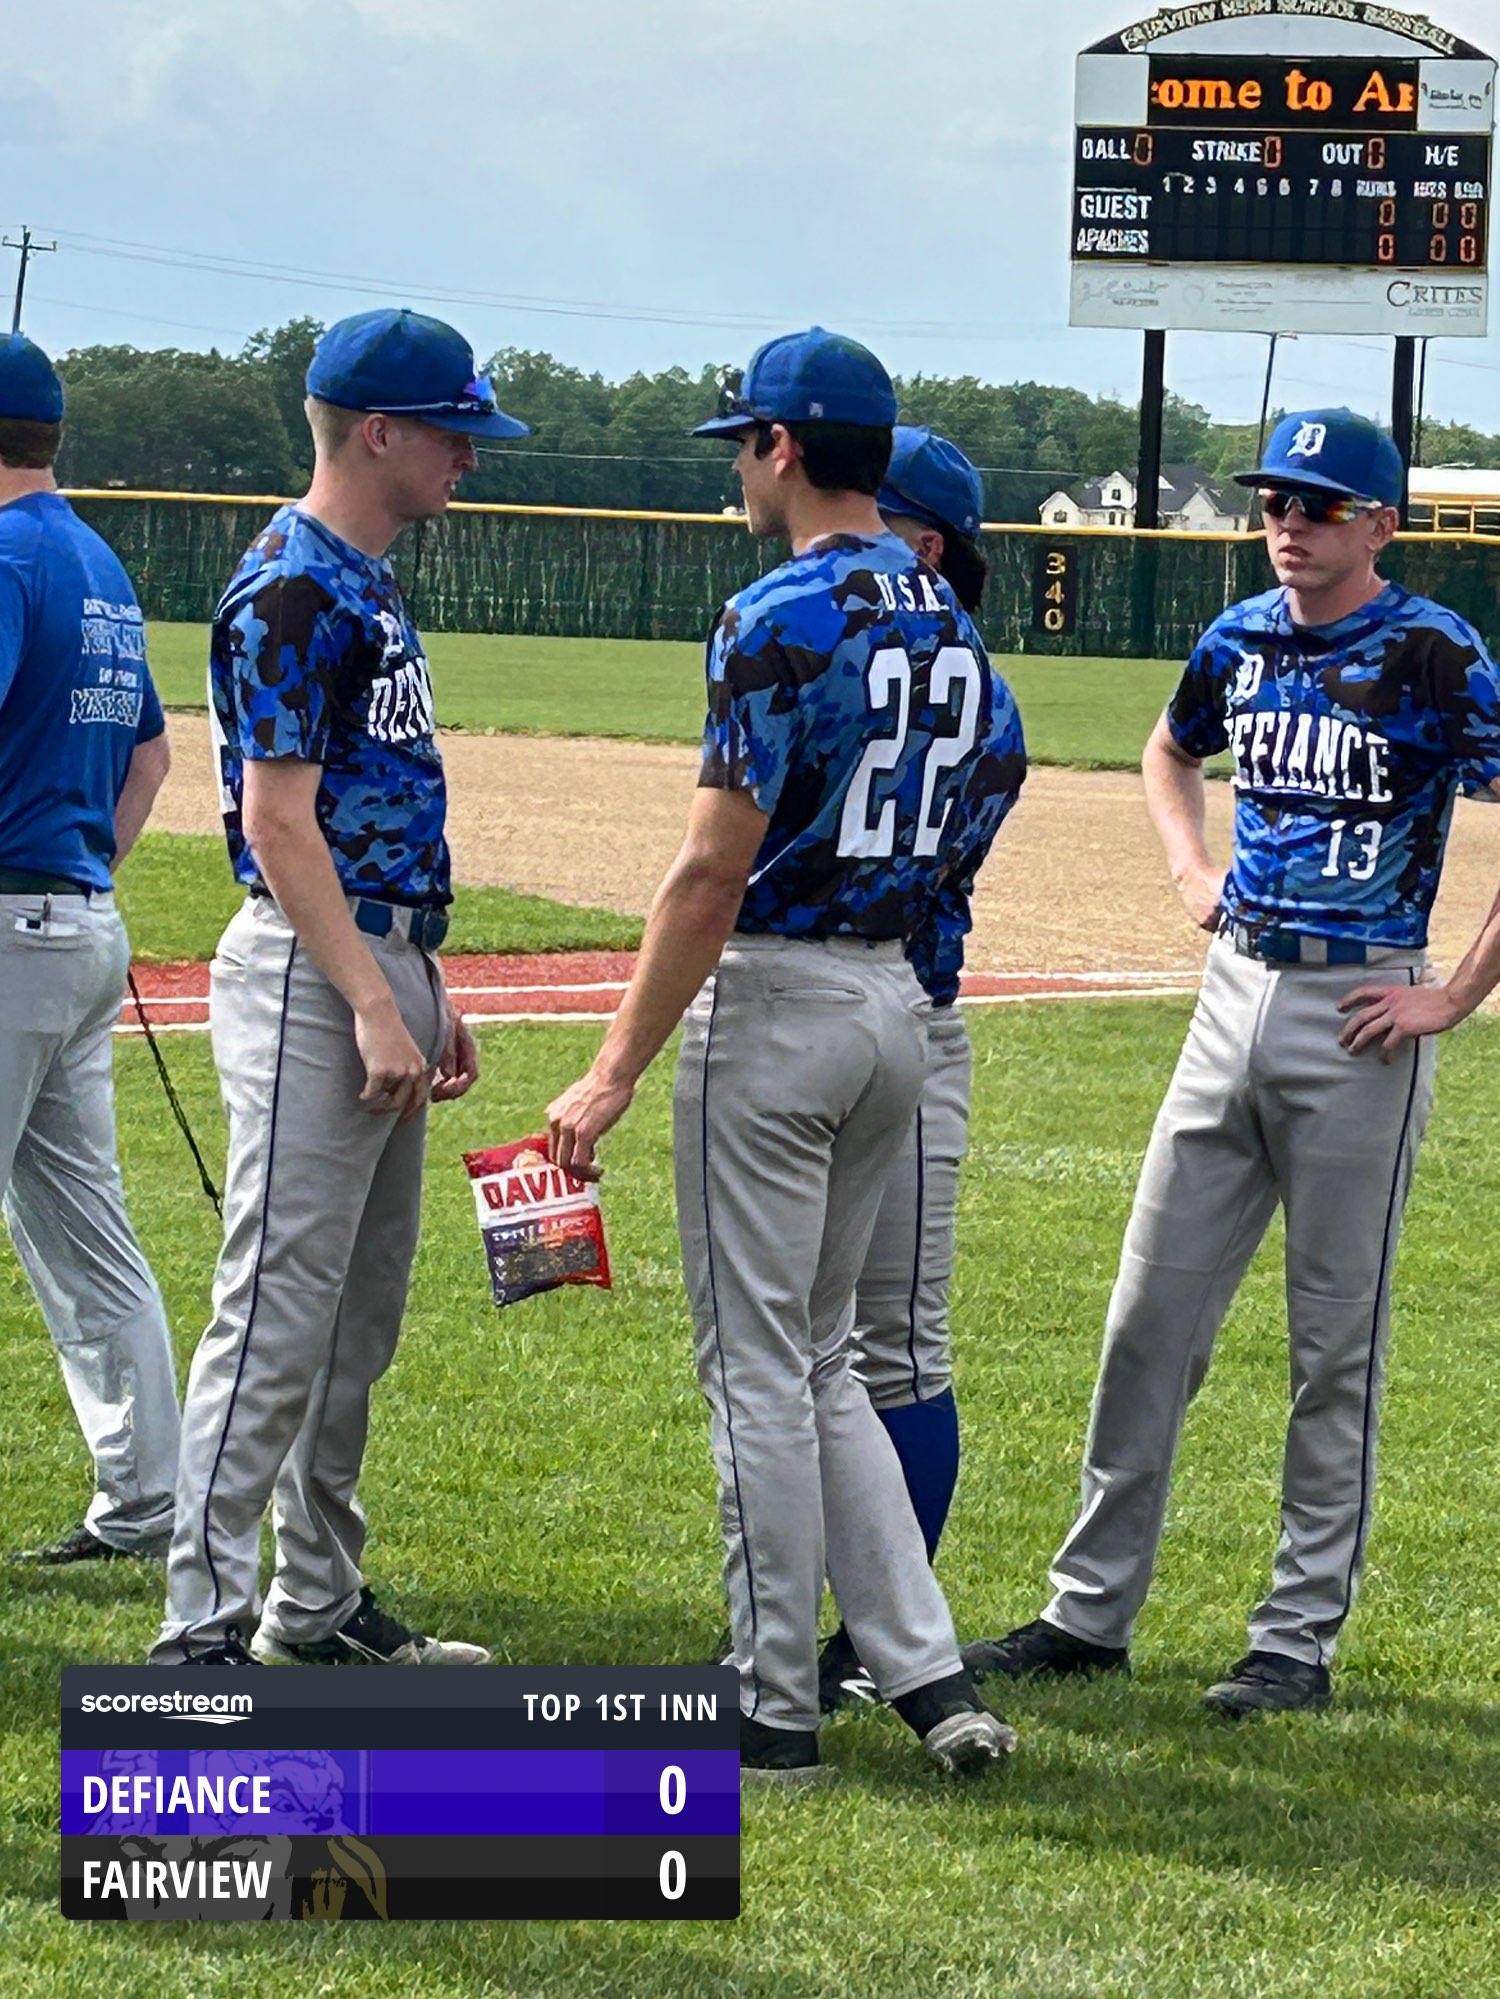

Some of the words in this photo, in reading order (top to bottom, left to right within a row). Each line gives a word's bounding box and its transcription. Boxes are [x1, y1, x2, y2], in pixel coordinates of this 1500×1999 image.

[1151, 79, 1261, 109] ome
[1284, 69, 1333, 111] to
[1082, 138, 1131, 159] BALL
[1192, 140, 1262, 162] STRIKE
[1322, 143, 1363, 165] OUT
[1183, 176, 1195, 193] 2
[1309, 179, 1319, 196] 7
[1080, 195, 1152, 219] GUEST
[1378, 234, 1395, 260] 0
[1460, 235, 1476, 262] 0
[836, 646, 981, 858] 22
[1321, 819, 1384, 880] 13
